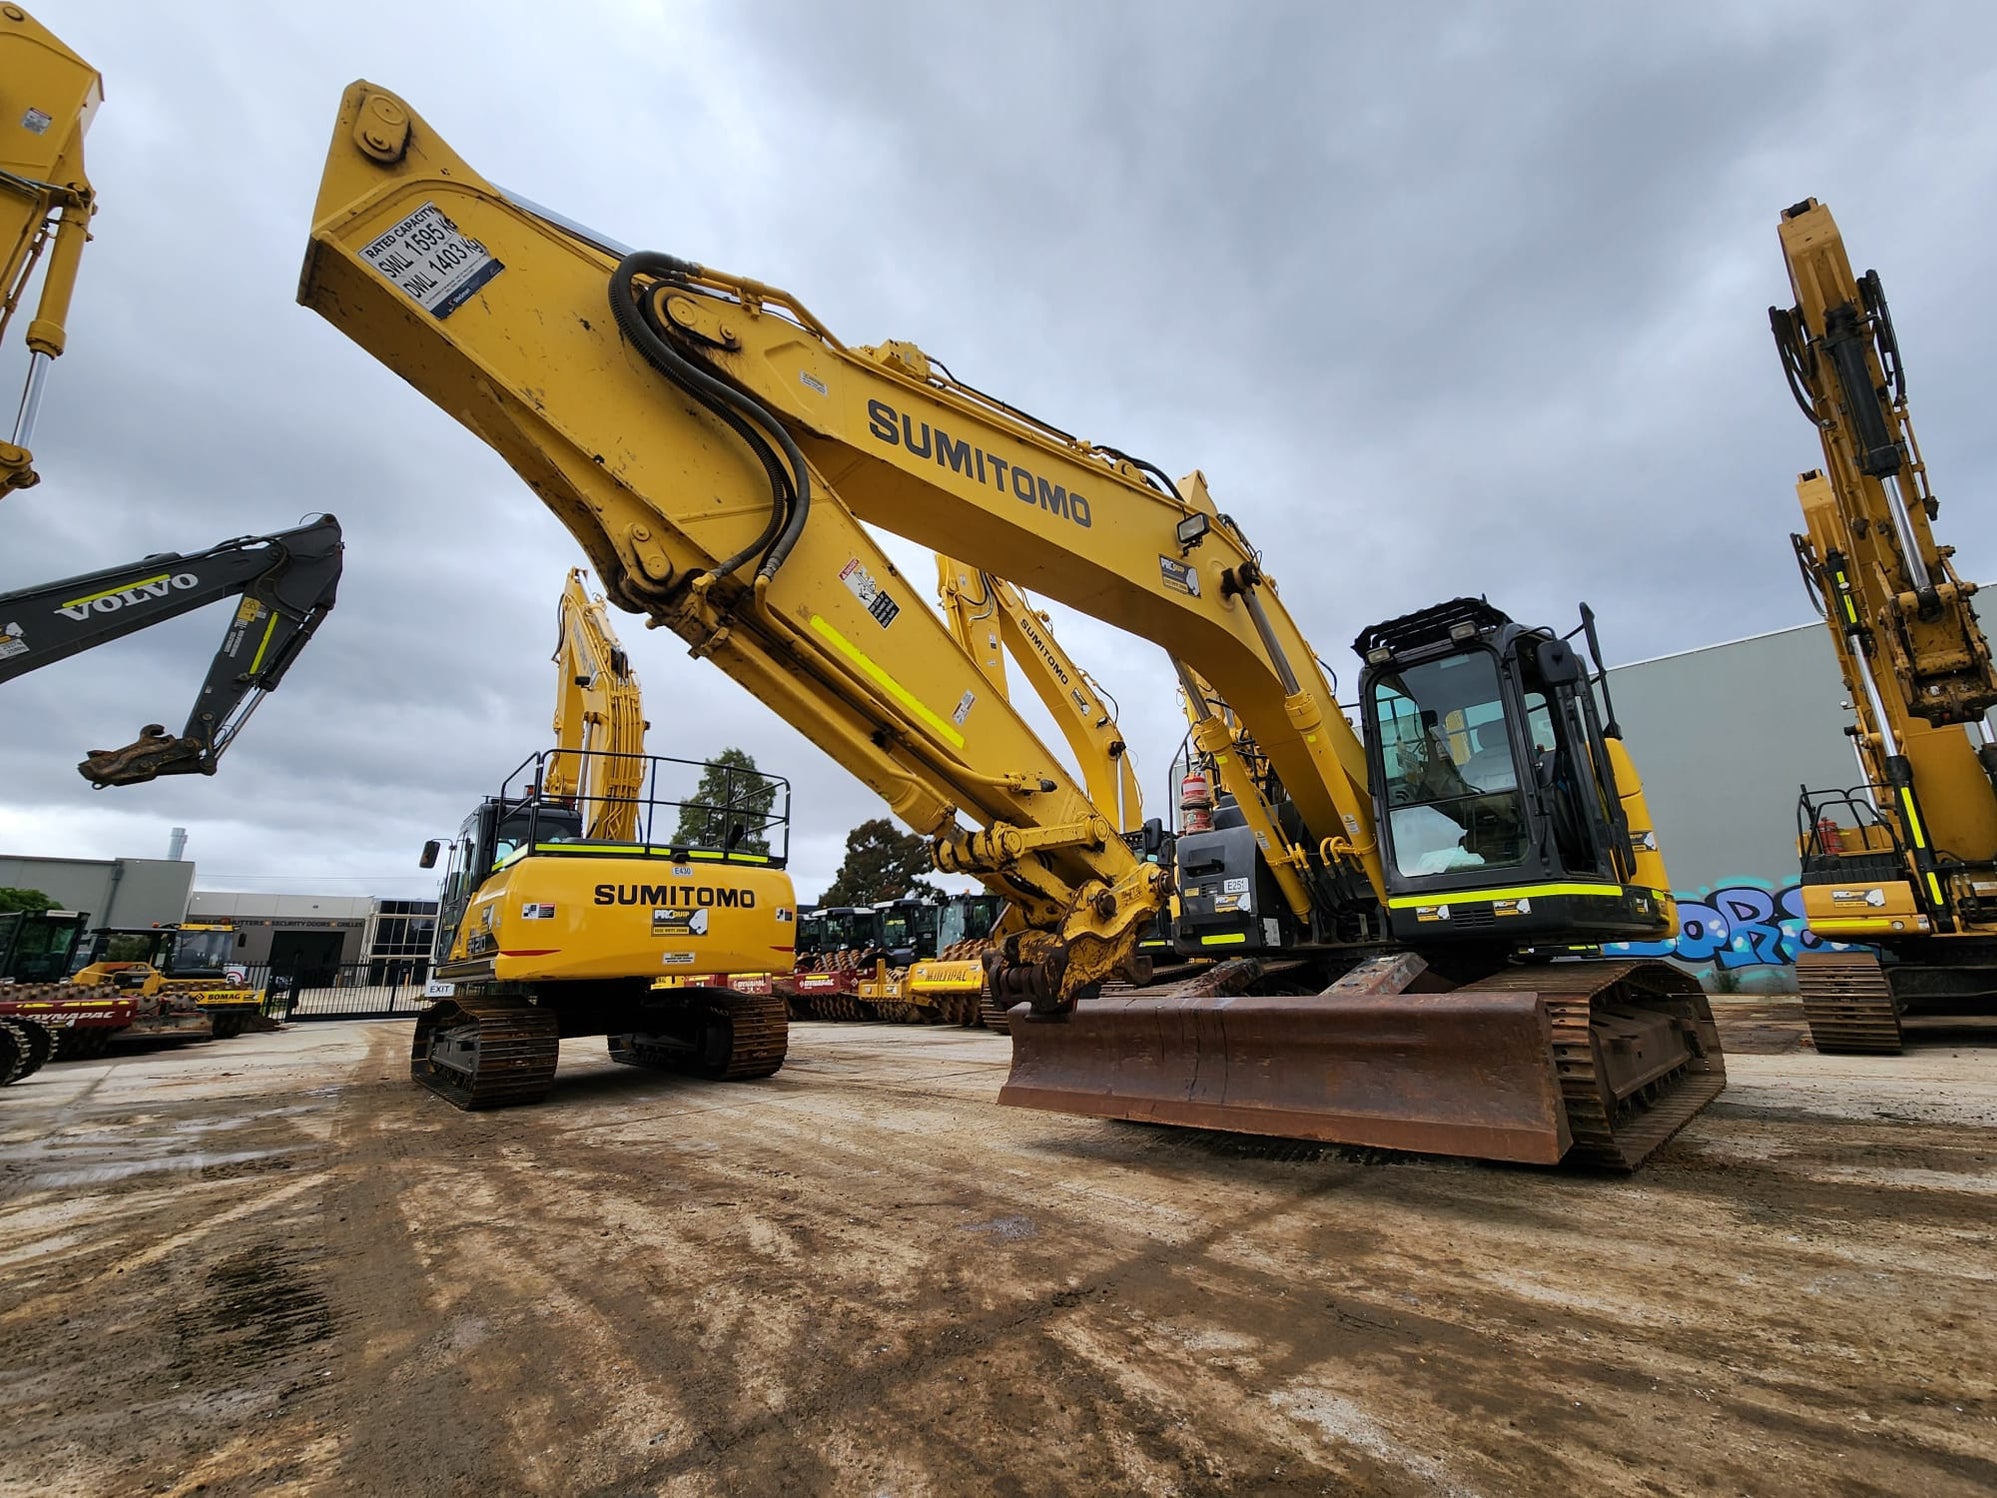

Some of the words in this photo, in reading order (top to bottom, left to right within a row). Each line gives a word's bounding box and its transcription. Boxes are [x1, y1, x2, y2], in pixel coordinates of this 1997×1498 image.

[365, 234, 396, 258] RATED
[394, 206, 434, 238] CAPACITY
[404, 223, 445, 256] 1595
[429, 243, 467, 276] 1403
[867, 398, 1092, 529] SUMITOMO
[53, 573, 199, 621] VOLVO
[1020, 618, 1069, 685] SUMITOMO
[594, 884, 755, 908] SUMITOMO
[430, 985, 450, 993] EXIT
[25, 1011, 116, 1020] DYNAPAC
